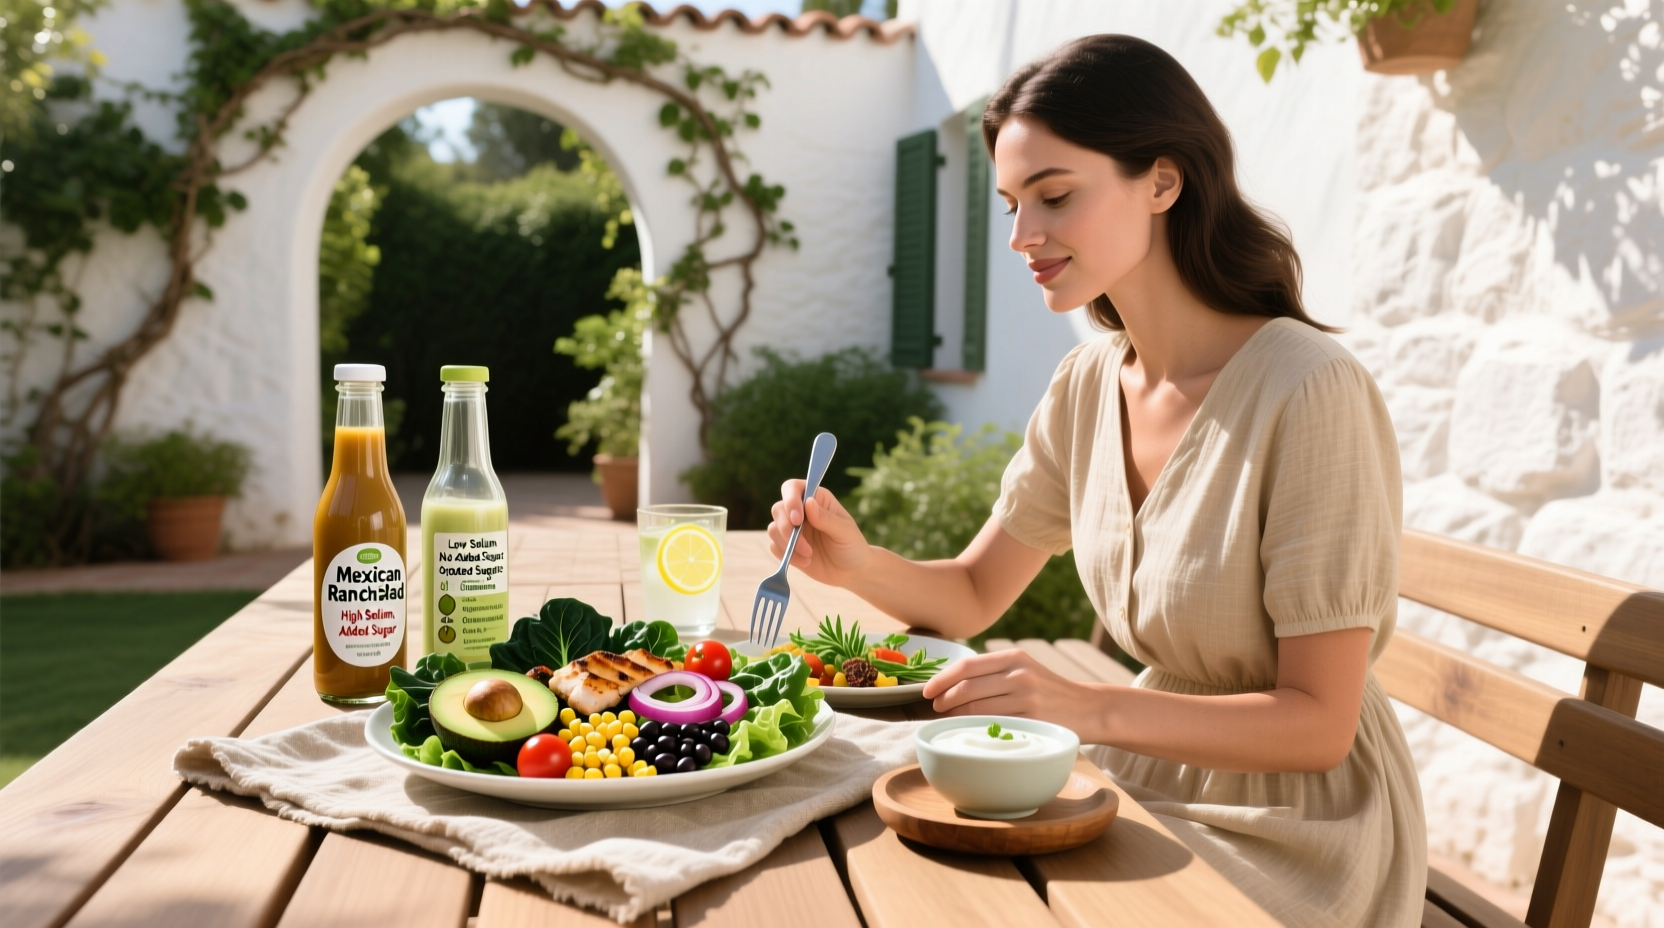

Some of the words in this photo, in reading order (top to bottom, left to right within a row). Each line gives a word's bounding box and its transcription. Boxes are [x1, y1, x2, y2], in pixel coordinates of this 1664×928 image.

[439, 552, 453, 562] No
[336, 565, 401, 583] Mexican
[341, 609, 363, 624] High
